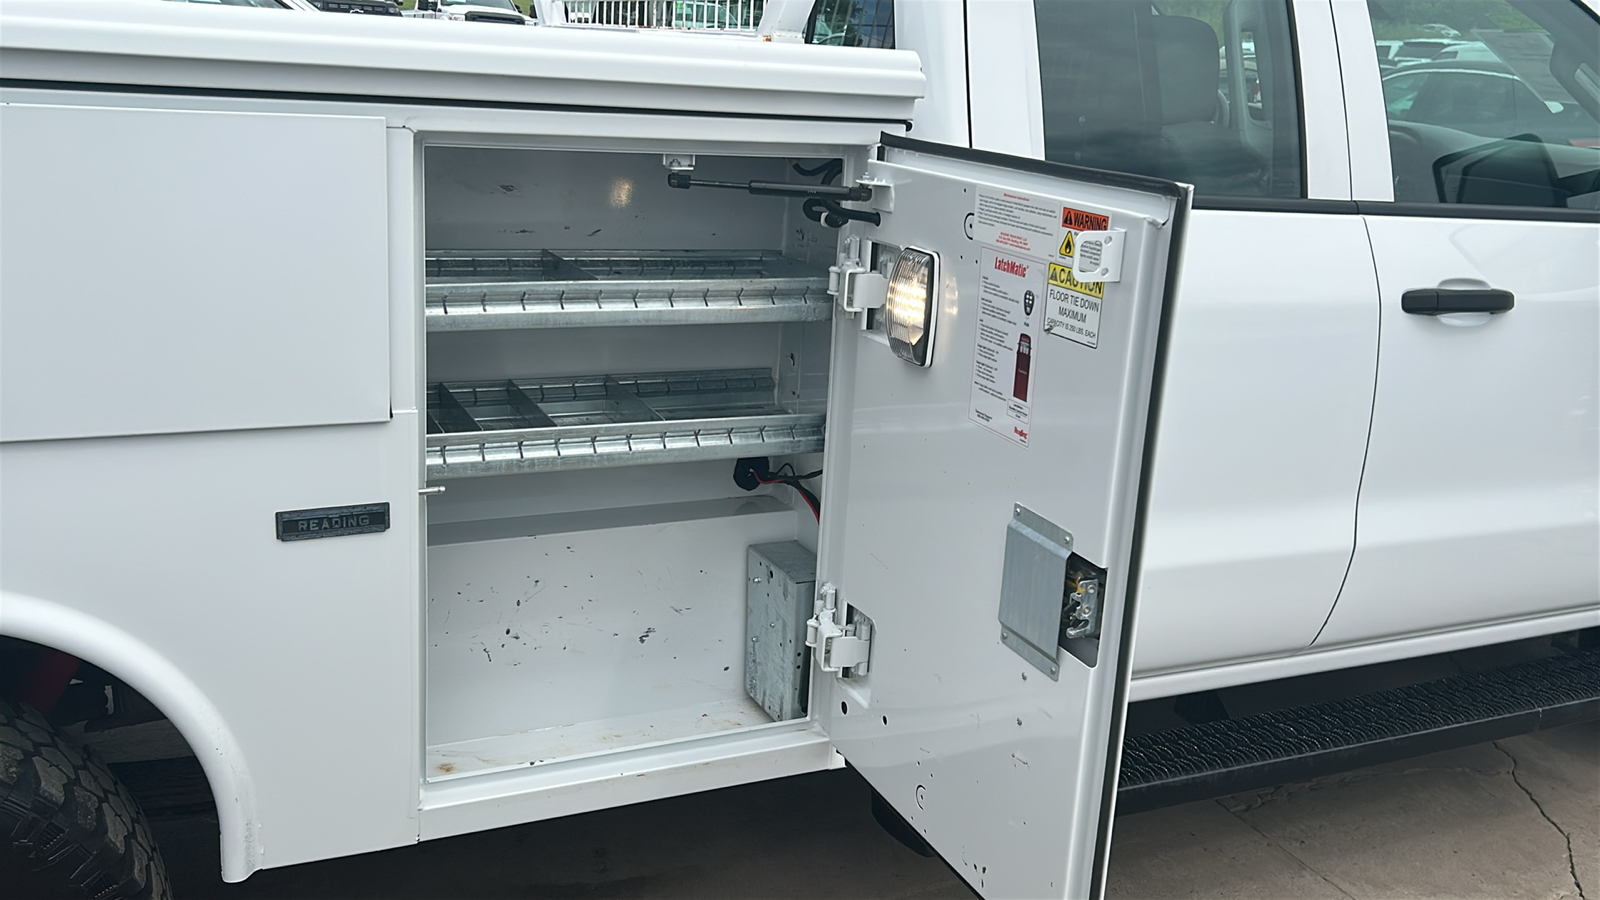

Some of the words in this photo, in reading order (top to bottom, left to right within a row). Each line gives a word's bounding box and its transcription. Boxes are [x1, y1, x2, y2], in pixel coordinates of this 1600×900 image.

[1073, 212, 1107, 231] WARNING
[994, 256, 1028, 278] LatchMatic
[1049, 288, 1069, 304] FLOOR
[1070, 295, 1079, 307] TIE
[1080, 298, 1099, 313] DOWN
[1058, 306, 1087, 323] MAXIMUM
[1085, 329, 1096, 339] EACH
[298, 515, 370, 532] READING
